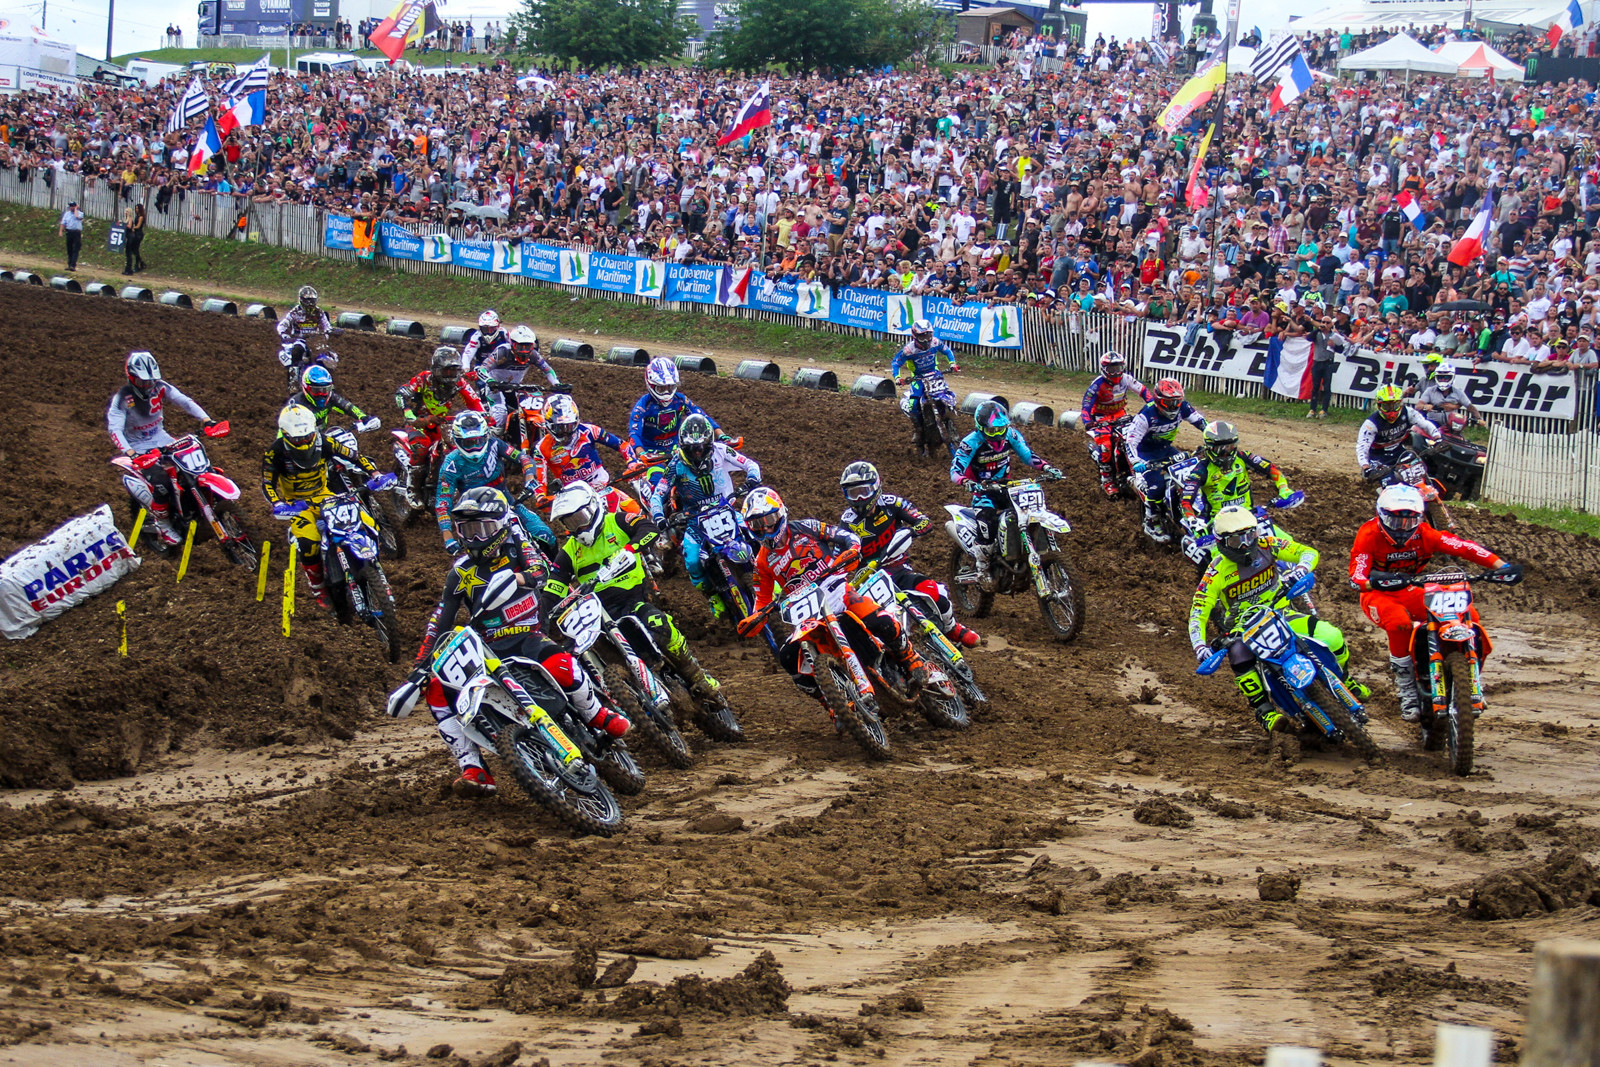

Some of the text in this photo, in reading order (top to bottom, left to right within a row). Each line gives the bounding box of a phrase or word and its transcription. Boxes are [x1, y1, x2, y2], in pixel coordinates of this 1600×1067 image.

[110, 232, 124, 246] 15
[382, 225, 389, 236] la
[388, 238, 420, 253] Maritime
[459, 247, 490, 262] Maritime
[523, 244, 558, 262] la Charente
[528, 258, 556, 274] Maritime
[591, 254, 634, 271] la Charente
[596, 269, 632, 285] Maritime
[669, 267, 714, 281] la Charente
[751, 275, 758, 285] la
[676, 281, 711, 294] Maritime
[844, 289, 884, 307] Charente
[841, 303, 884, 321] Maritime
[927, 300, 978, 318] la Charente
[934, 316, 975, 333] Maritime
[1147, 329, 1237, 371] Bihr
[1455, 367, 1570, 412] Bihr
[520, 397, 544, 410] 46
[182, 449, 207, 471] 10
[561, 461, 596, 483] Red Bull
[698, 493, 723, 506] YAMAHA
[702, 511, 736, 540] 193
[863, 519, 896, 558] SHOT
[1387, 551, 1417, 560] HITACHI
[23, 531, 128, 602] PARTS
[805, 559, 828, 581] Bull
[30, 548, 136, 613] EUROPE
[790, 591, 820, 625] 61
[1430, 592, 1468, 614] 426
[563, 602, 599, 634] 29
[493, 625, 531, 638] JUMBO
[443, 638, 483, 687] 64
